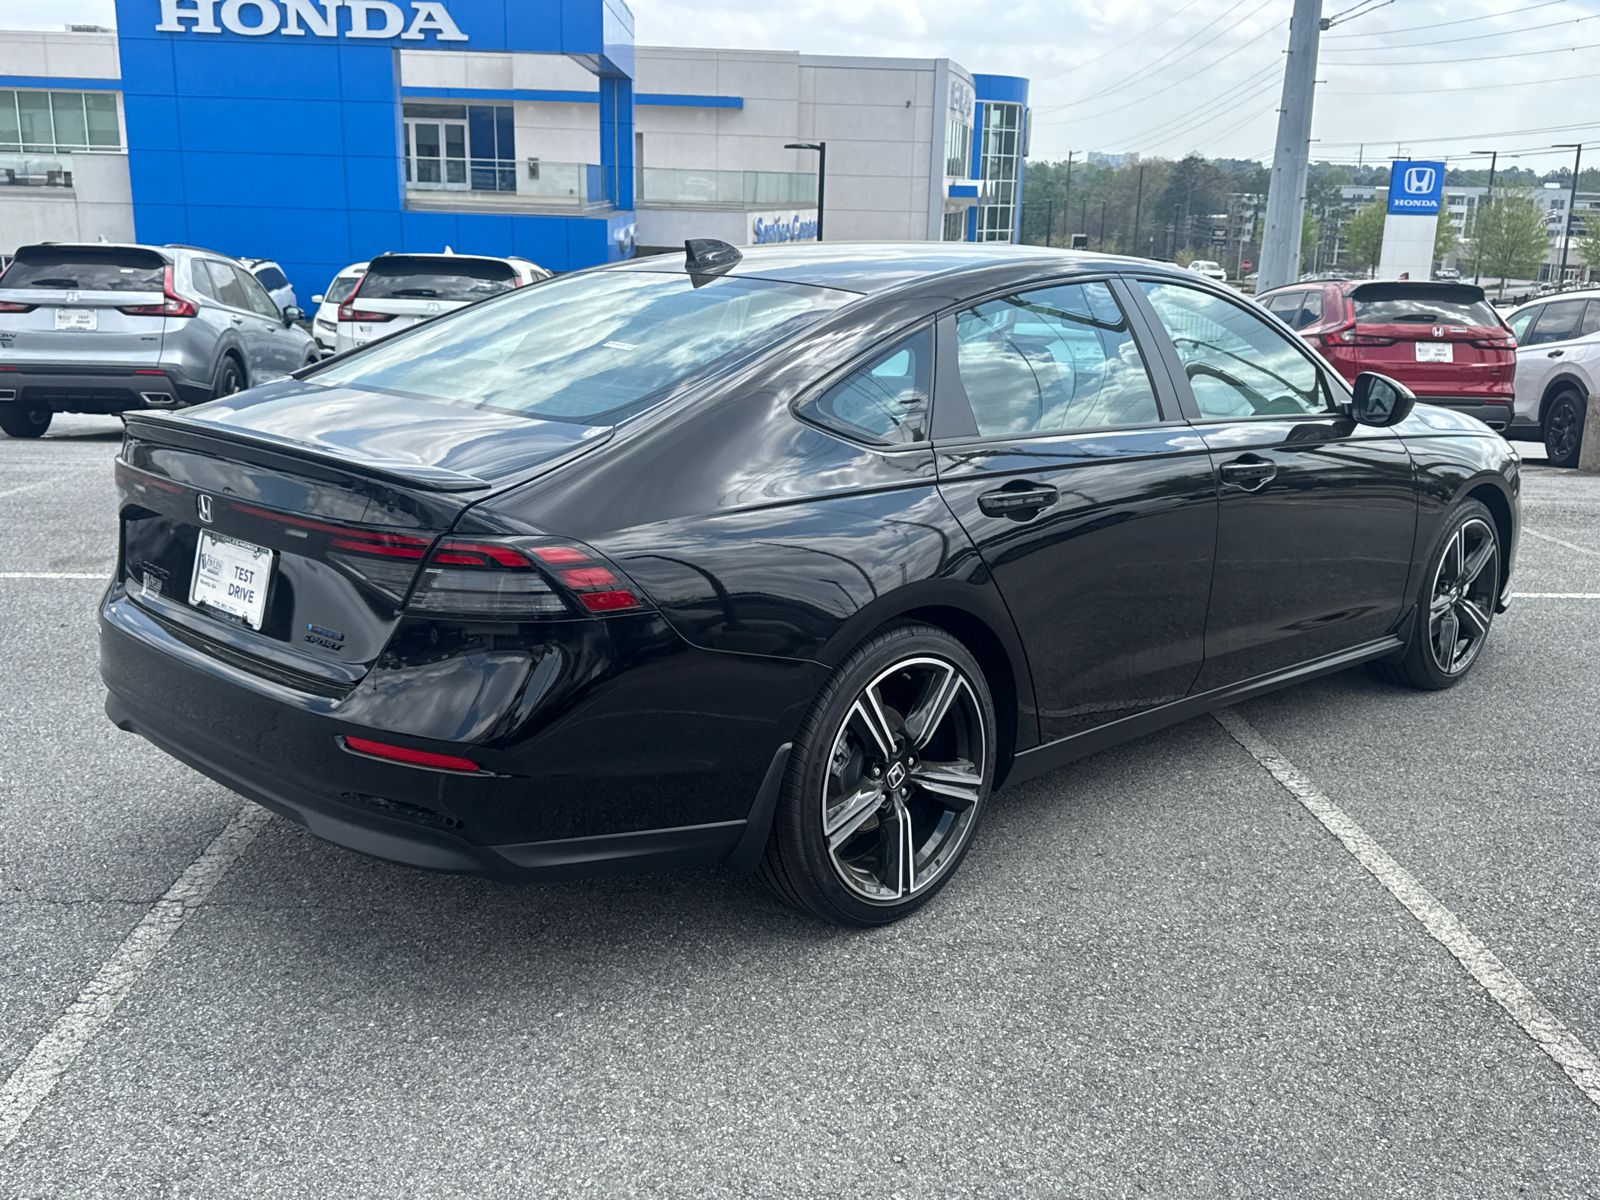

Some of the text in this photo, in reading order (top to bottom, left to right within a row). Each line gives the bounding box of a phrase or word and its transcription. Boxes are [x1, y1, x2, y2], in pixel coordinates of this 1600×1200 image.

[155, 0, 469, 41] HONDA
[1394, 199, 1438, 207] HONDA
[791, 214, 818, 240] Cente
[234, 565, 255, 584] TEST
[228, 583, 255, 604] DRIVE
